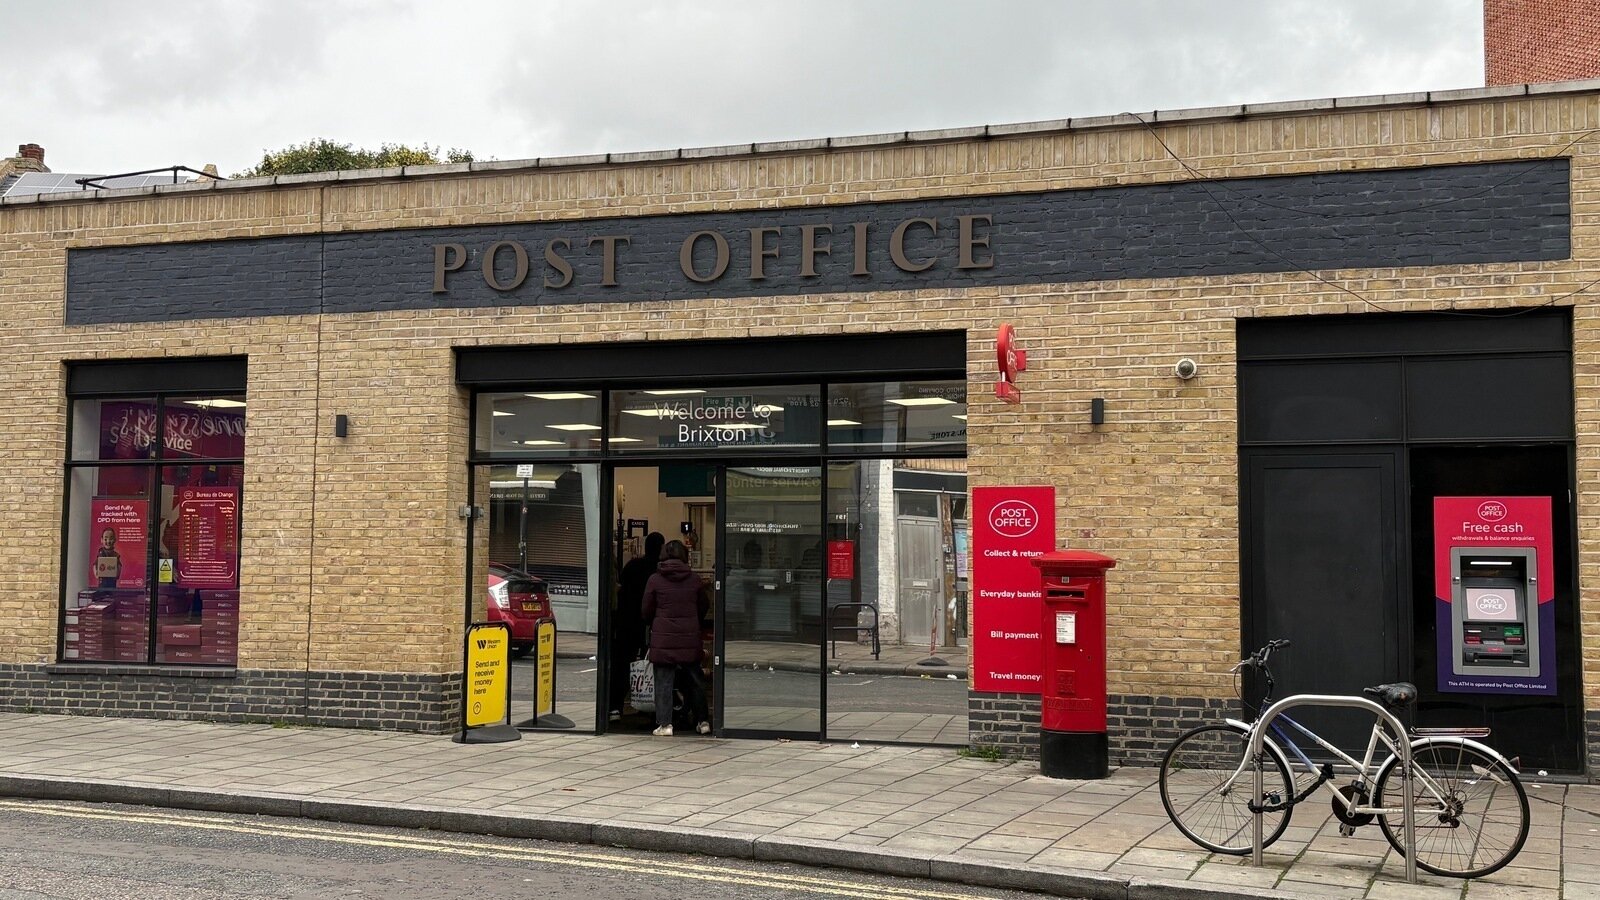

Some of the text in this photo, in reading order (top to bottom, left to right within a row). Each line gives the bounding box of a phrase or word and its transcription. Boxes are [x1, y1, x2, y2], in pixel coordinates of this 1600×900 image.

[432, 213, 995, 293] POST OFFICE
[654, 400, 746, 420] Welcome
[752, 404, 771, 418] to
[678, 423, 746, 442] Brixton
[1001, 508, 1027, 517] POST
[995, 518, 1031, 527] OFFICE
[1462, 521, 1523, 533] Free cash
[984, 549, 1011, 557] Collect
[980, 589, 1016, 599] Everyday
[990, 630, 1003, 638] Bill
[474, 669, 495, 677] receive
[989, 671, 1041, 681] Travel money
